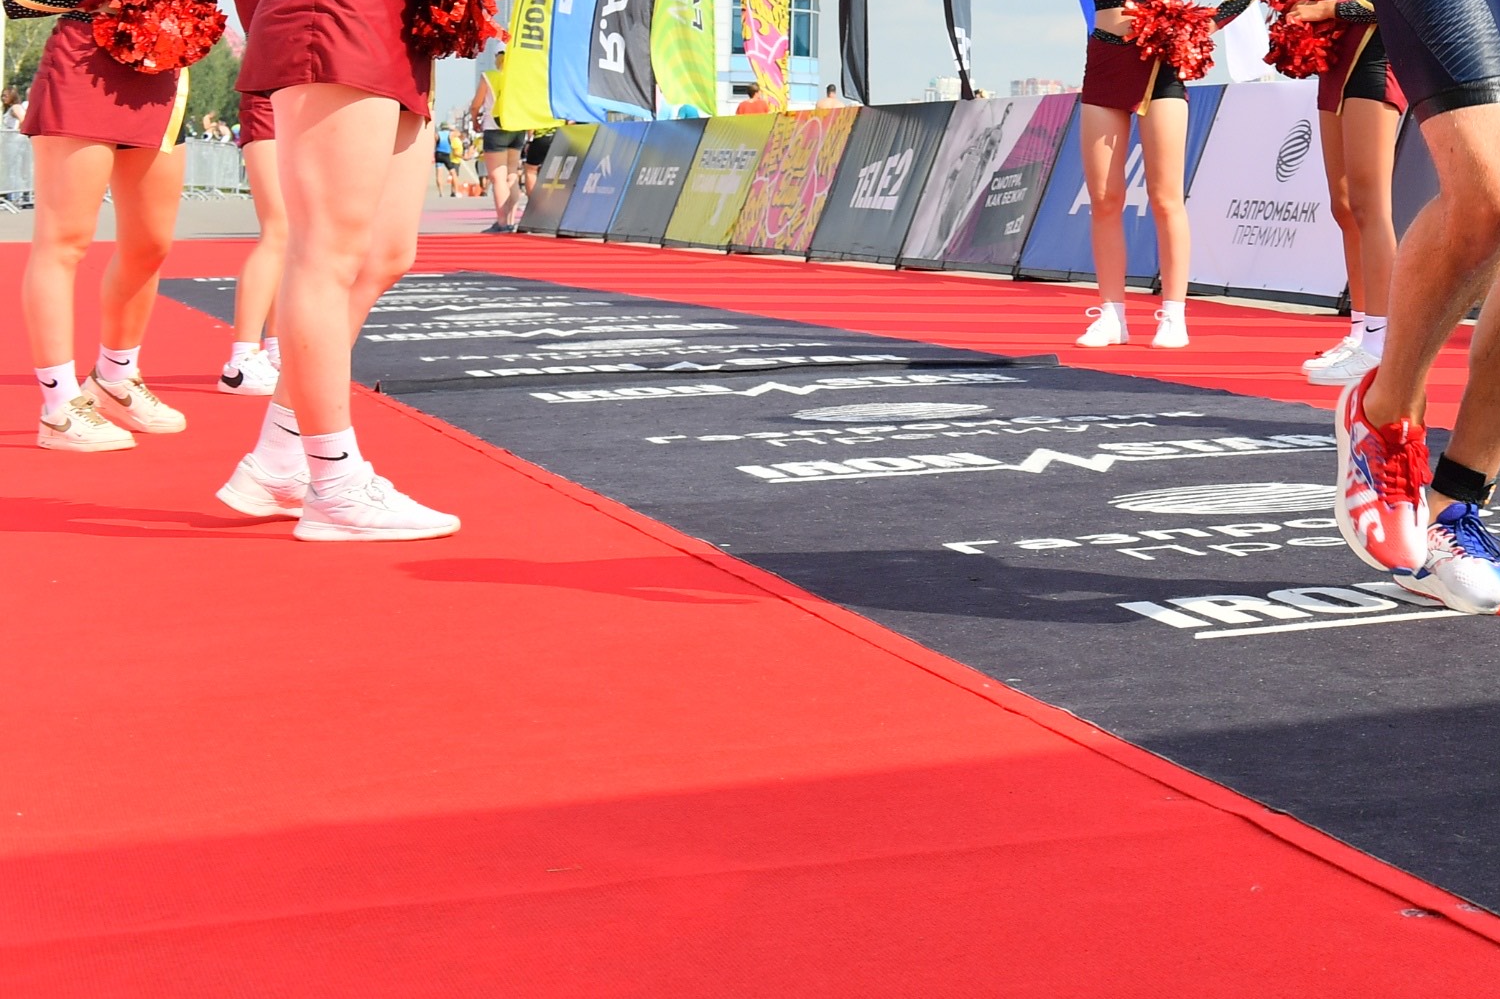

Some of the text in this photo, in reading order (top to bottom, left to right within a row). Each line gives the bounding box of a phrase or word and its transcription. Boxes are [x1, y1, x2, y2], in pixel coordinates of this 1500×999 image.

[849, 147, 914, 211] TELE2
[1226, 199, 1320, 223] ГАЗПРОМБАНК
[1232, 225, 1297, 248] ПРЕМИУМ
[530, 373, 1018, 401] IRON STAR
[734, 433, 1337, 479] IRON STAR
